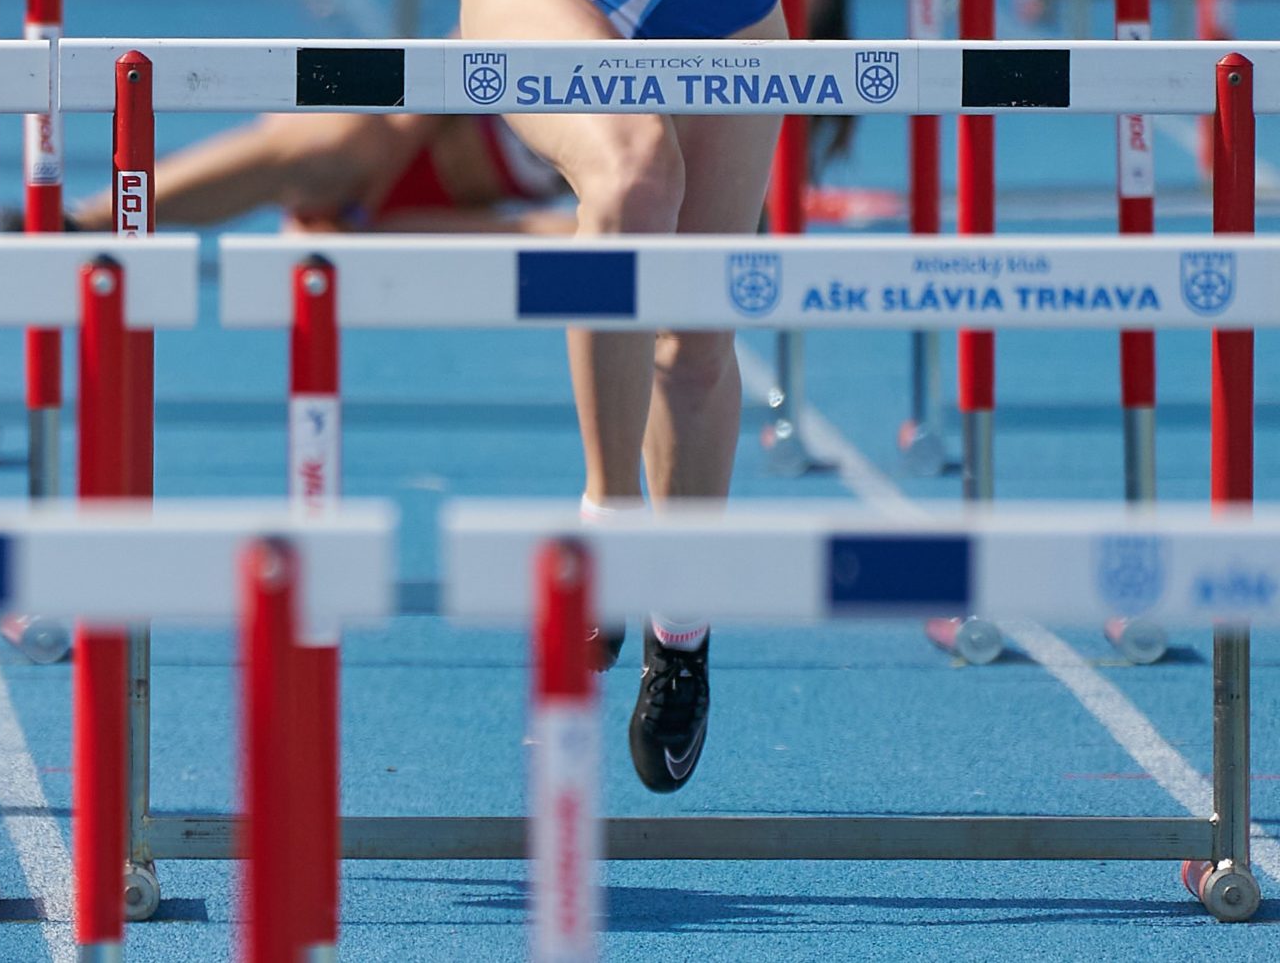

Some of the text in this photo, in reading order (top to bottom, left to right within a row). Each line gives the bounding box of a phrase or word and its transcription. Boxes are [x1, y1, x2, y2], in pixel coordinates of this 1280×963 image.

[598, 55, 761, 69] ATLETICKÝ KLUB
[516, 64, 844, 105] SLÁVIA TRNAVA
[801, 281, 1162, 312] AŠK SLÁVIA TRNAVA
